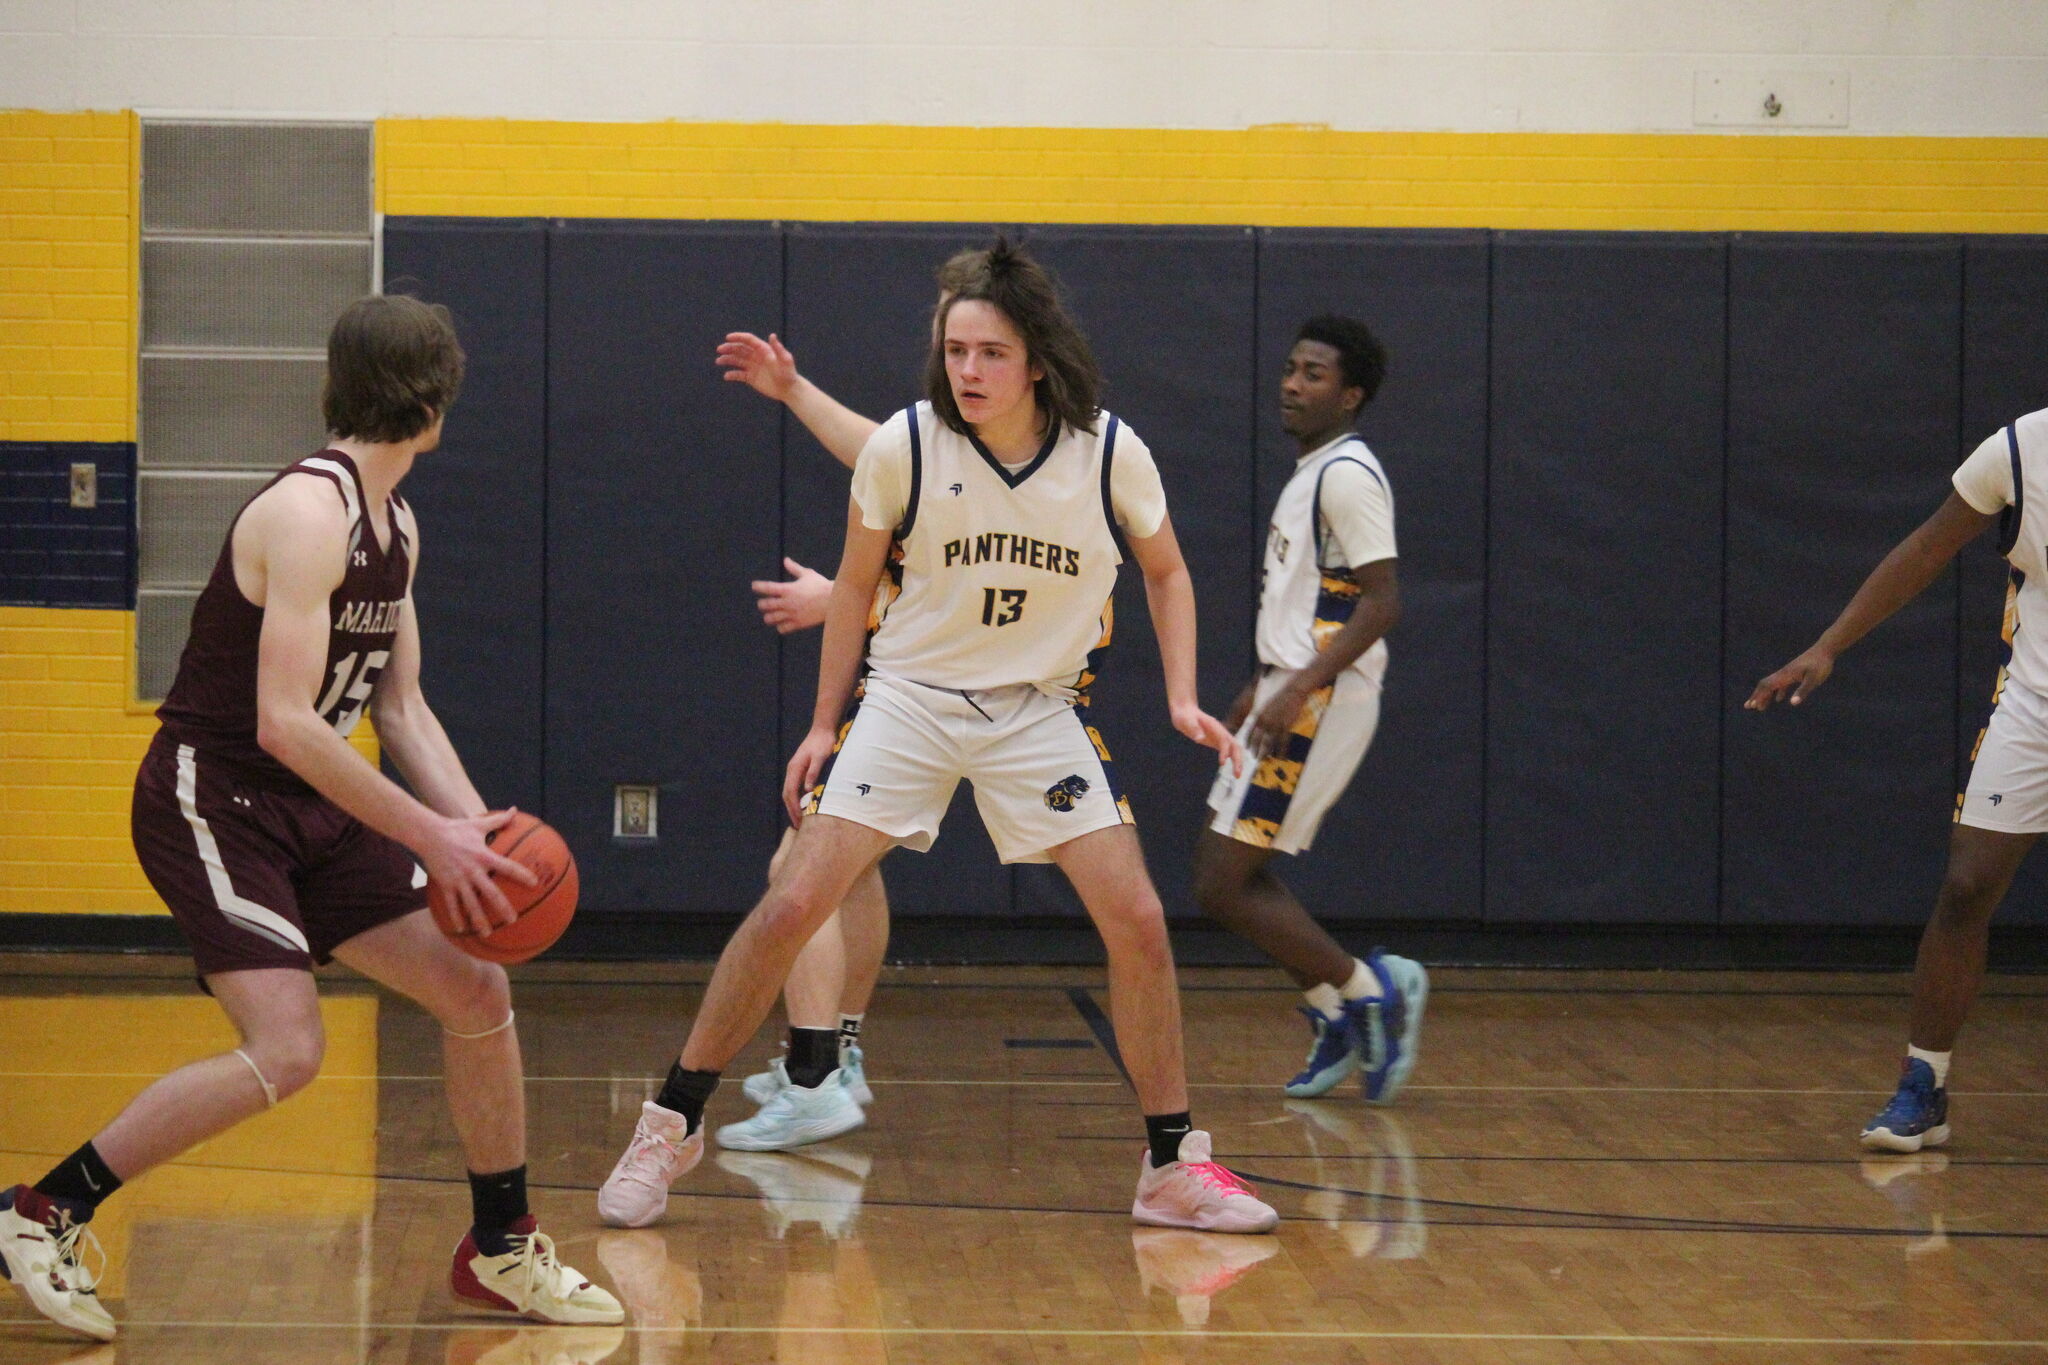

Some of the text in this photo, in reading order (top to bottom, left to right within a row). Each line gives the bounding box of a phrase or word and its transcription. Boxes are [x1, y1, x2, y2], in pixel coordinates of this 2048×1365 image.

[944, 532, 1080, 576] PANTHERS
[982, 587, 1028, 627] 13
[317, 650, 391, 737] 15
